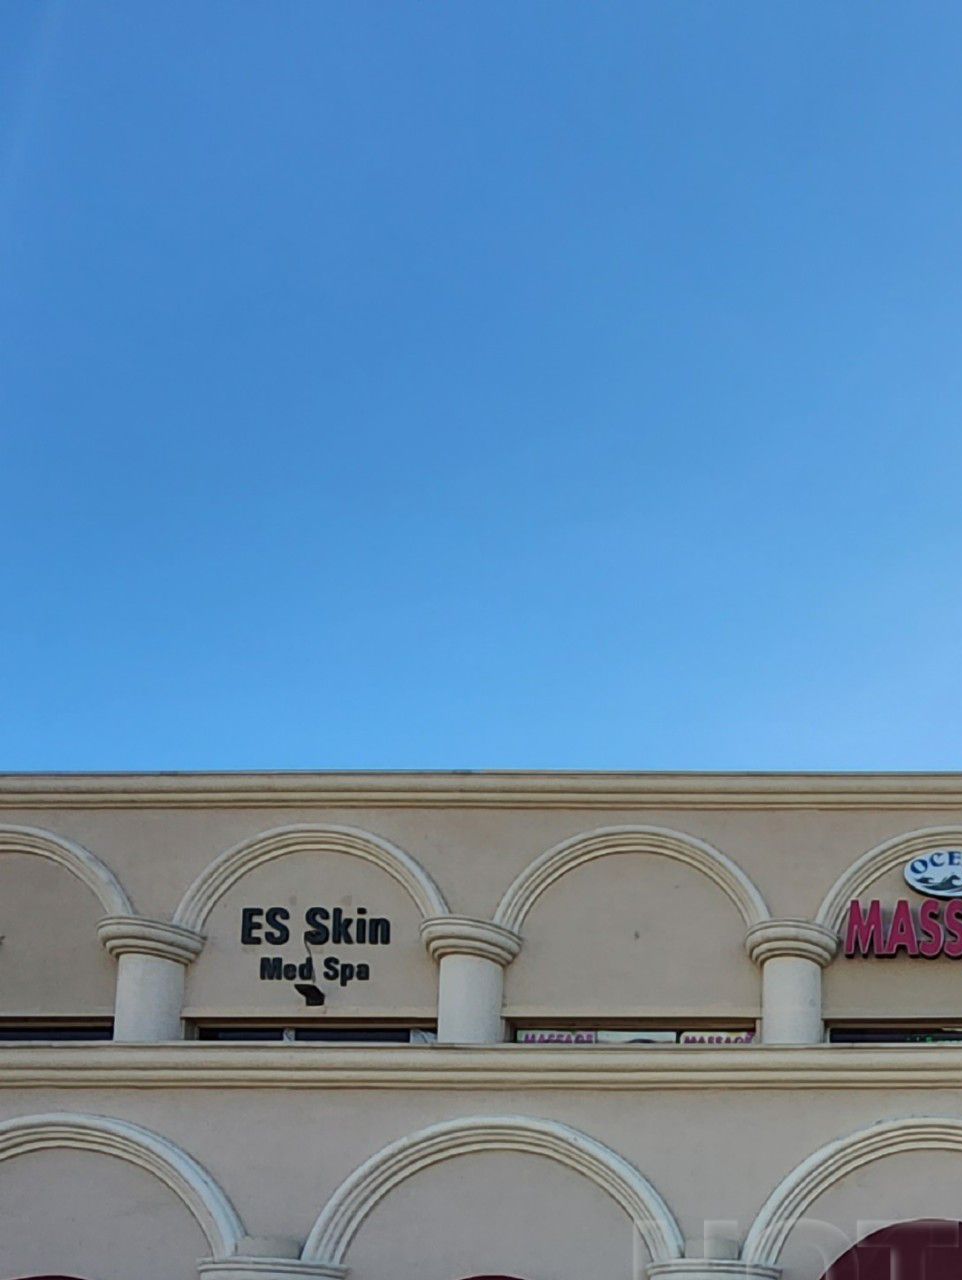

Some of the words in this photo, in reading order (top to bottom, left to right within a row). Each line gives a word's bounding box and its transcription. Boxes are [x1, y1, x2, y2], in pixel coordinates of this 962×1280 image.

[241, 907, 290, 945] ES
[304, 907, 391, 945] Skin
[259, 957, 314, 981] Med
[323, 957, 370, 986] Spa
